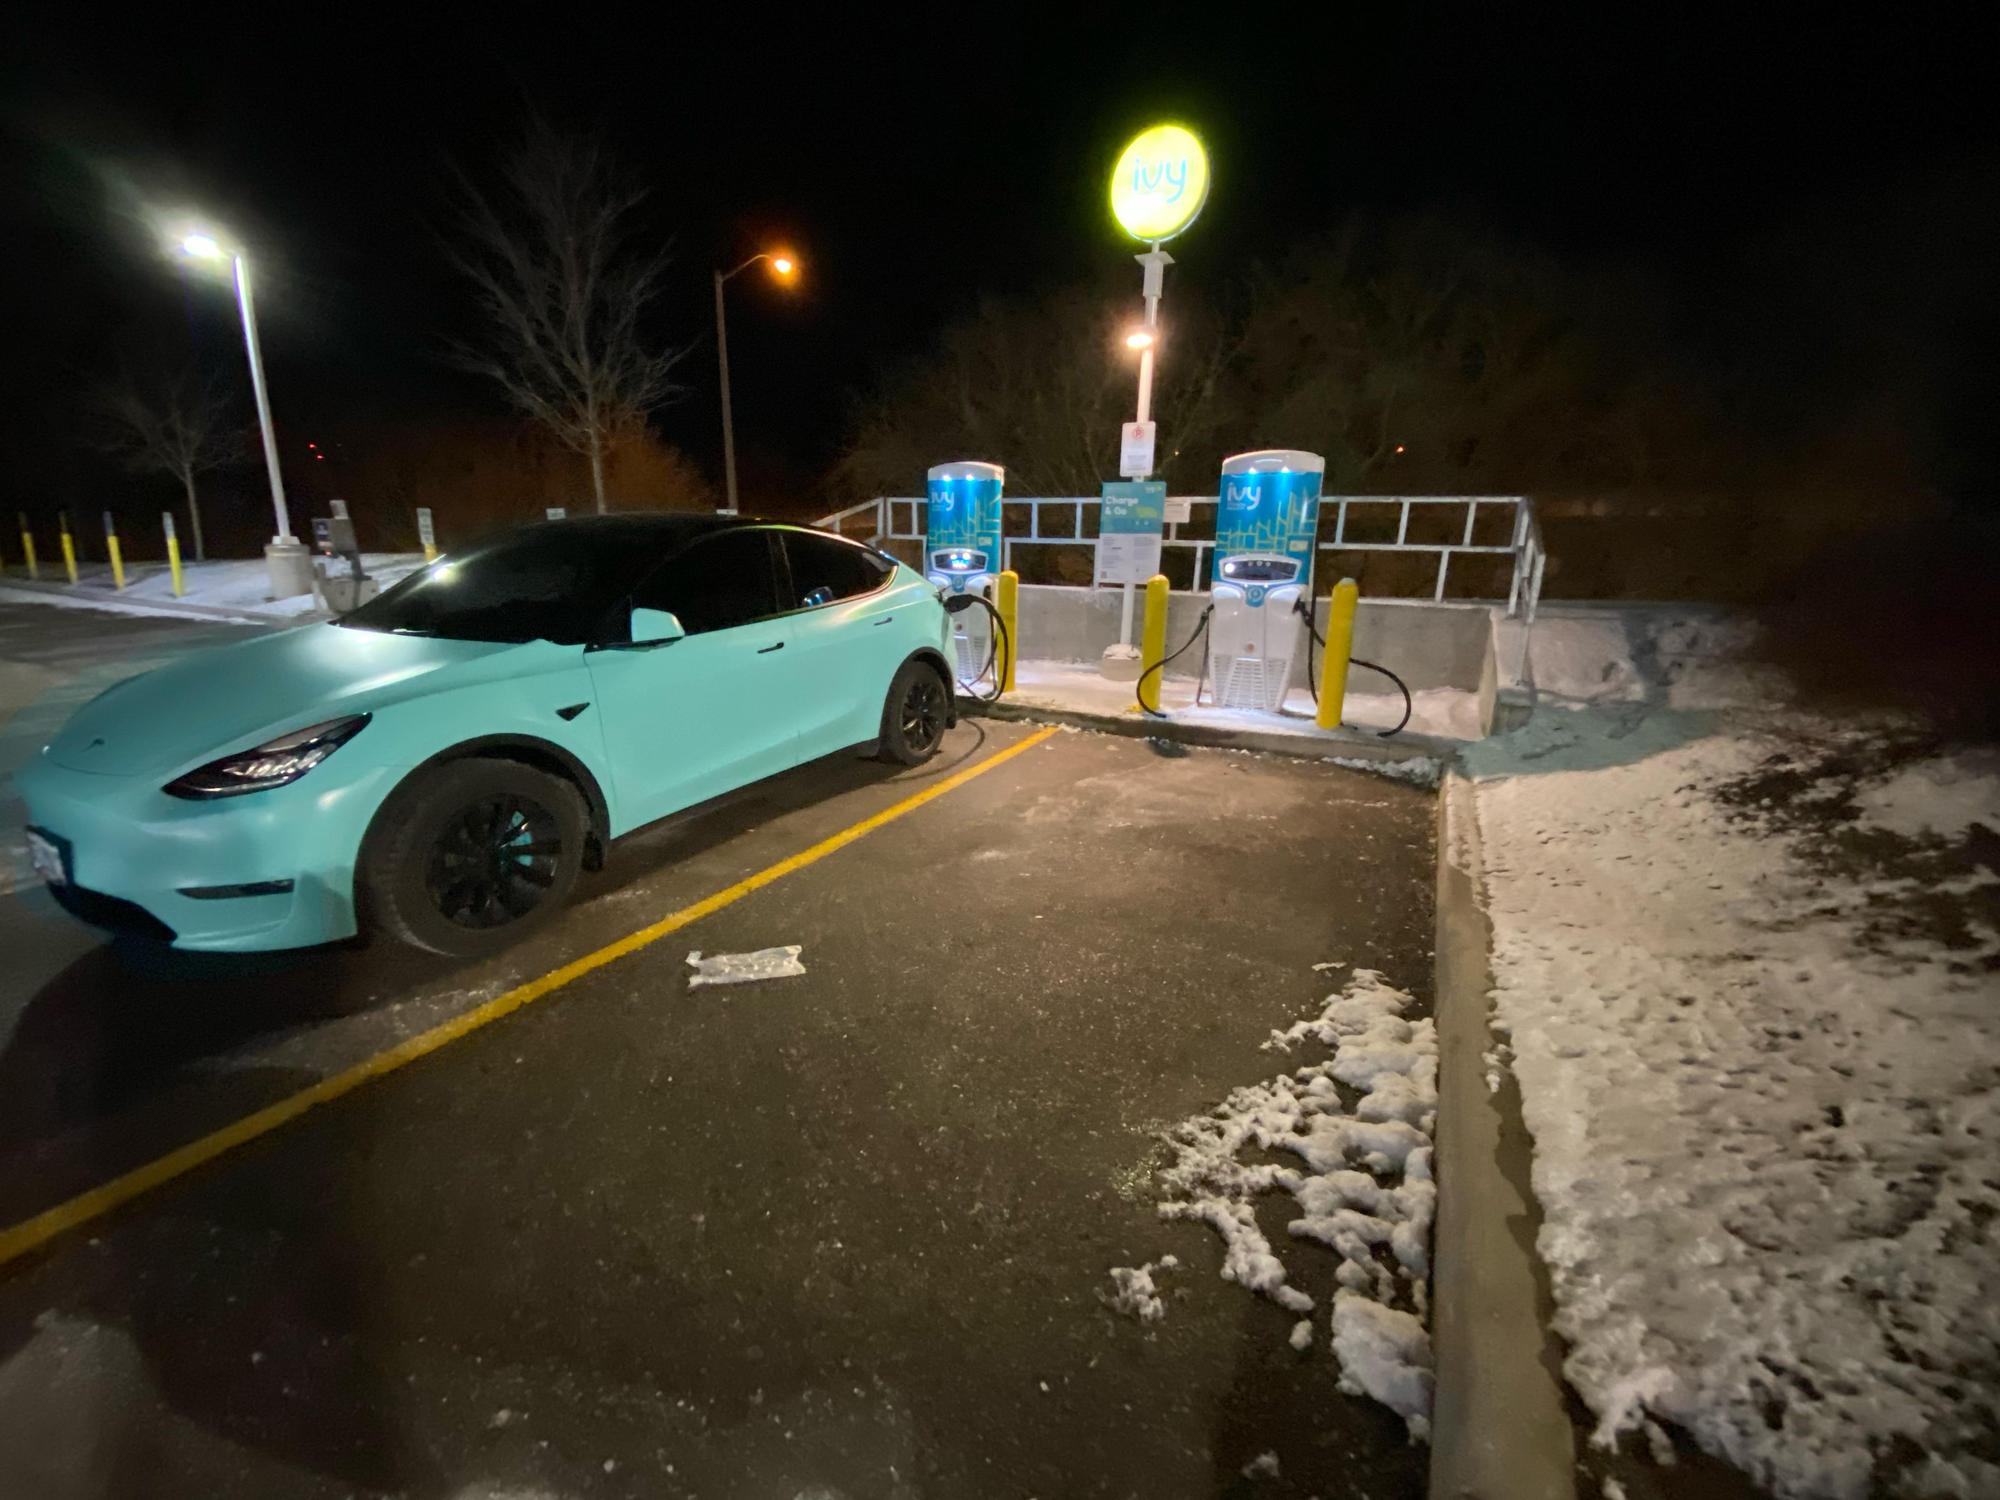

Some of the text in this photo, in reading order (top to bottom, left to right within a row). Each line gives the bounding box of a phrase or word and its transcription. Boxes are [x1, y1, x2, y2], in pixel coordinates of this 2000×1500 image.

[1132, 157, 1187, 205] ivy
[931, 487, 955, 512] ivy
[1227, 481, 1261, 511] ivy
